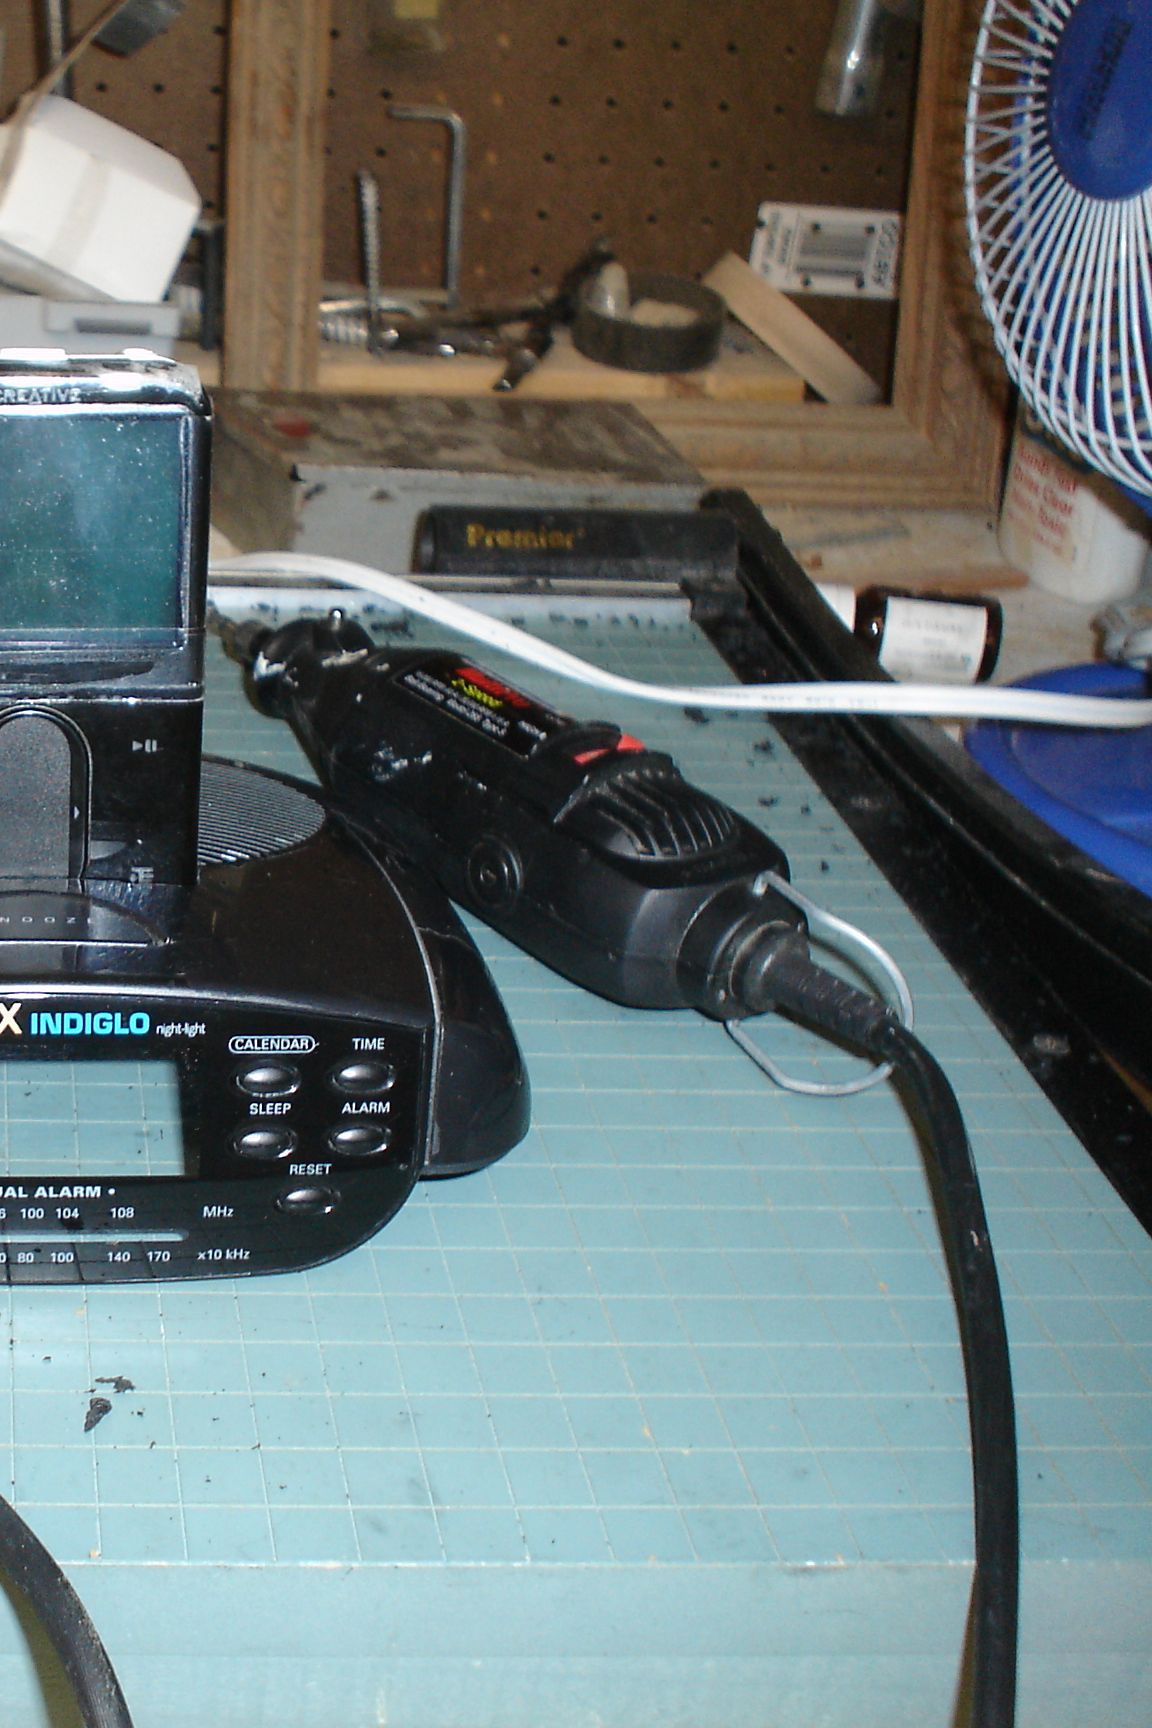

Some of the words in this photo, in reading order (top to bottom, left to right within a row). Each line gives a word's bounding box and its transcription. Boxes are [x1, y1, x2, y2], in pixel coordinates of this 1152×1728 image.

[30, 1012, 150, 1035] INDIGLO
[155, 1022, 206, 1038] night-light
[234, 1037, 310, 1051] CALENDAR
[352, 1037, 385, 1050] TIME
[249, 1102, 292, 1115] SLEEP
[341, 1101, 391, 1114] ALARM
[289, 1163, 332, 1175] RESET
[33, 1185, 102, 1199] ALARM
[20, 1207, 45, 1219] 100
[55, 1207, 80, 1219] 104
[110, 1206, 135, 1219] 108
[203, 1205, 234, 1218] MHz
[17, 1252, 35, 1263] 80
[50, 1251, 74, 1263] 100
[107, 1251, 131, 1262] 140
[147, 1250, 171, 1262] 170
[197, 1248, 223, 1260] x10
[225, 1248, 250, 1260] kHz
